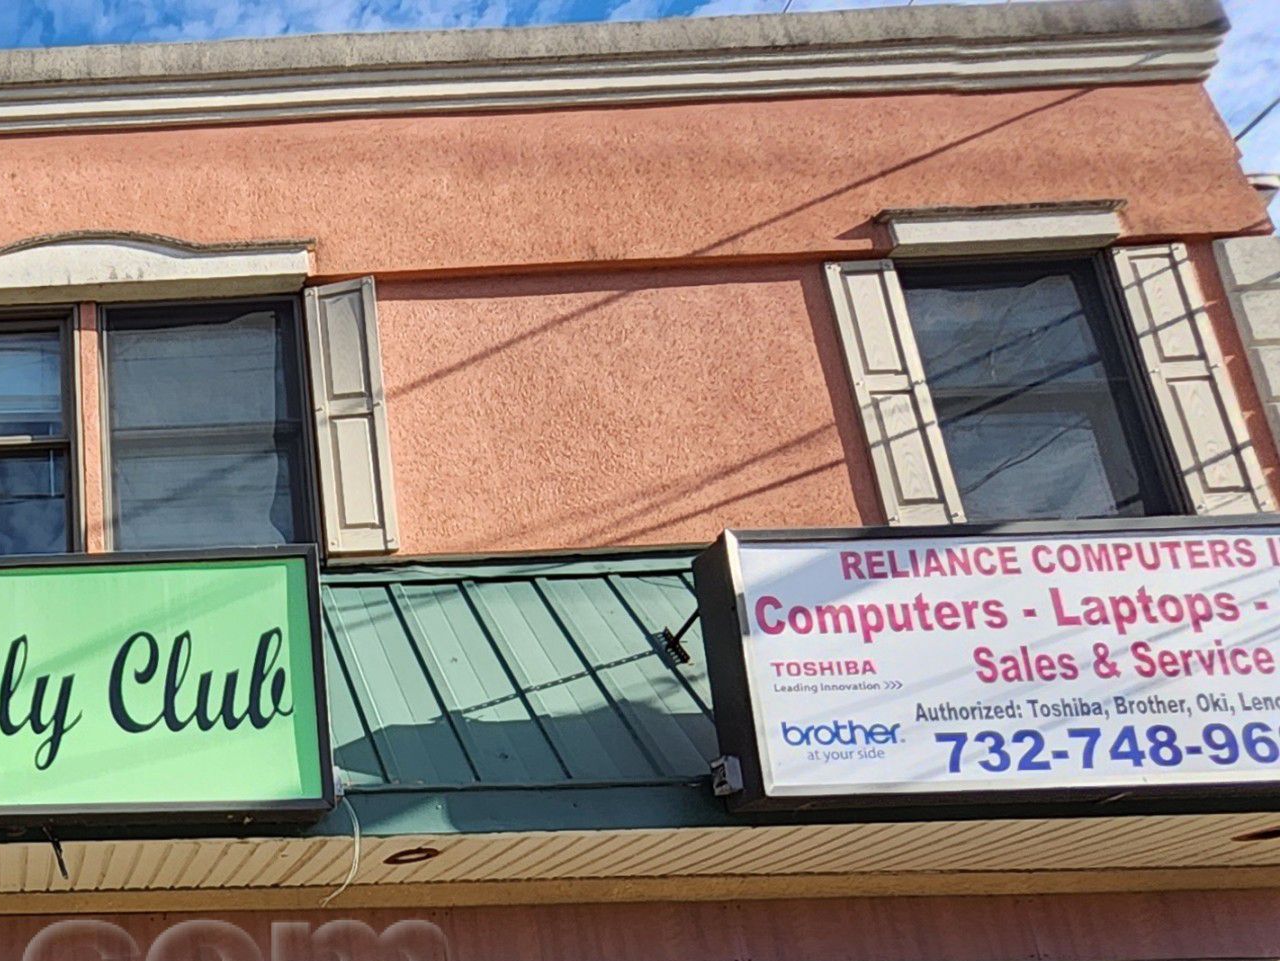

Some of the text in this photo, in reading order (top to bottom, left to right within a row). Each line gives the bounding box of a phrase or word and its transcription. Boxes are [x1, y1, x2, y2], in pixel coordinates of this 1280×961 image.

[839, 537, 1280, 580] RELIANCE COMPUTERS I
[754, 592, 1008, 643] Computers
[1048, 585, 1240, 635] Laptops
[769, 659, 878, 677] TOSHIBA
[972, 639, 1275, 684] Sales & Service
[107, 627, 295, 735] Club
[773, 681, 881, 695] Leading Innovation
[915, 700, 1023, 722] Authorized:
[1026, 697, 1110, 720] Toshiba,
[1114, 695, 1193, 718] Brother,
[1196, 692, 1236, 715] Oki,
[780, 720, 902, 747] brother
[934, 721, 1280, 773] 732-748-96
[807, 747, 886, 763] at your side
